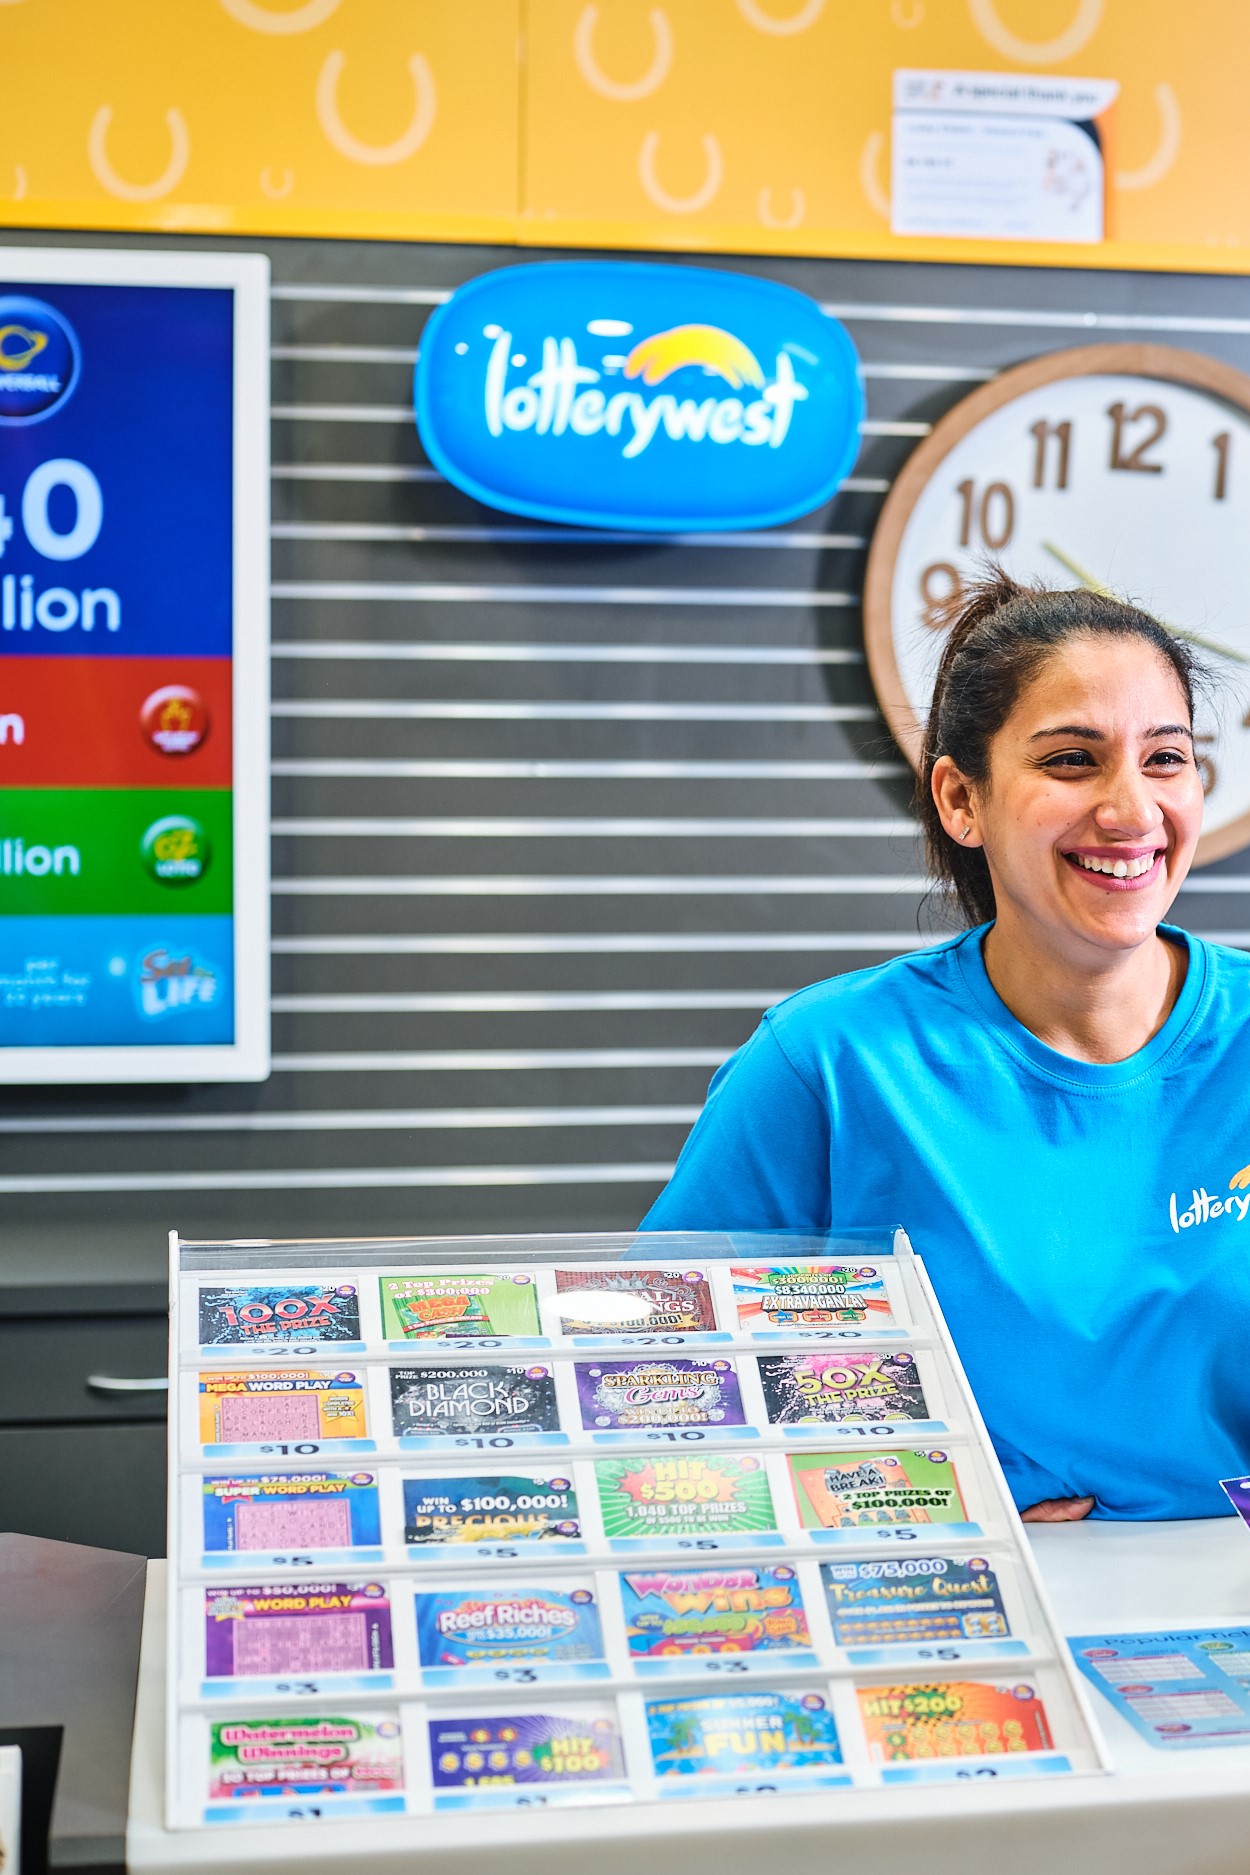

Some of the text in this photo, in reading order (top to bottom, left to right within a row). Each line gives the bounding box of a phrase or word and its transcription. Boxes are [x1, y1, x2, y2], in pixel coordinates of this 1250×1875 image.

[484, 331, 809, 458] lotterywest
[1108, 403, 1168, 473] 12
[1030, 420, 1072, 489] 11
[1211, 431, 1231, 500] 1
[956, 479, 1015, 549] 10
[0, 838, 81, 877] lion
[388, 1278, 495, 1290] 2 Top Prizes
[775, 1284, 845, 1295] $8,340,000
[394, 1287, 491, 1298] of $300,000
[218, 1293, 341, 1326] 100X
[407, 1296, 472, 1314] MEGA
[762, 1295, 867, 1310] EXTRAVAGANZA!
[418, 1306, 467, 1321] CASH
[240, 1315, 332, 1336] THE PRIZE
[437, 1340, 503, 1349] $20
[621, 1337, 685, 1345] $20
[252, 1347, 317, 1355] $20
[249, 1372, 309, 1380] $100,000!
[420, 1370, 488, 1379] $200,000
[507, 1367, 524, 1375] $10
[793, 1361, 893, 1395] 50X
[206, 1380, 331, 1393] MEGA WORD PLAY
[603, 1373, 717, 1387] SPARKLING
[427, 1381, 509, 1400] BLACK
[626, 1385, 703, 1404] Gems
[804, 1383, 899, 1407] THE PRIZE
[409, 1397, 529, 1417] DIAMOND
[619, 1413, 708, 1424] $200,000!
[647, 1431, 705, 1441] $10
[837, 1426, 895, 1436] $10
[260, 1444, 319, 1455] $10
[455, 1437, 514, 1448] $10
[655, 1460, 706, 1482] HIT
[829, 1468, 879, 1482] HAVE A
[260, 1474, 326, 1484] $75,000!
[215, 1483, 346, 1496] SUPER WORD PLAY
[639, 1479, 720, 1500] $500
[856, 1491, 881, 1499] TOP
[885, 1489, 932, 1497] PRIZES
[422, 1497, 450, 1505] WIN
[461, 1494, 569, 1512] $100,000!
[852, 1497, 948, 1510] $100,000!
[417, 1504, 457, 1513] UP TO
[671, 1503, 698, 1516] TOP
[701, 1502, 748, 1513] PRIZES
[877, 1529, 918, 1540] $5
[859, 1558, 948, 1579] $75,000
[262, 1585, 337, 1595] $50,000!
[829, 1574, 994, 1602] Treasure Quest
[253, 1598, 306, 1611] WORD
[308, 1596, 352, 1609] PLAY
[439, 1602, 577, 1633] Reef Riches
[1104, 1633, 1199, 1645] Popular
[495, 1670, 537, 1683] $3
[862, 1695, 963, 1717] HIT $200
[225, 1723, 354, 1741] Watermelon
[551, 1738, 593, 1756] HIT
[704, 1731, 788, 1757] FUN
[242, 1746, 342, 1760] Winnings
